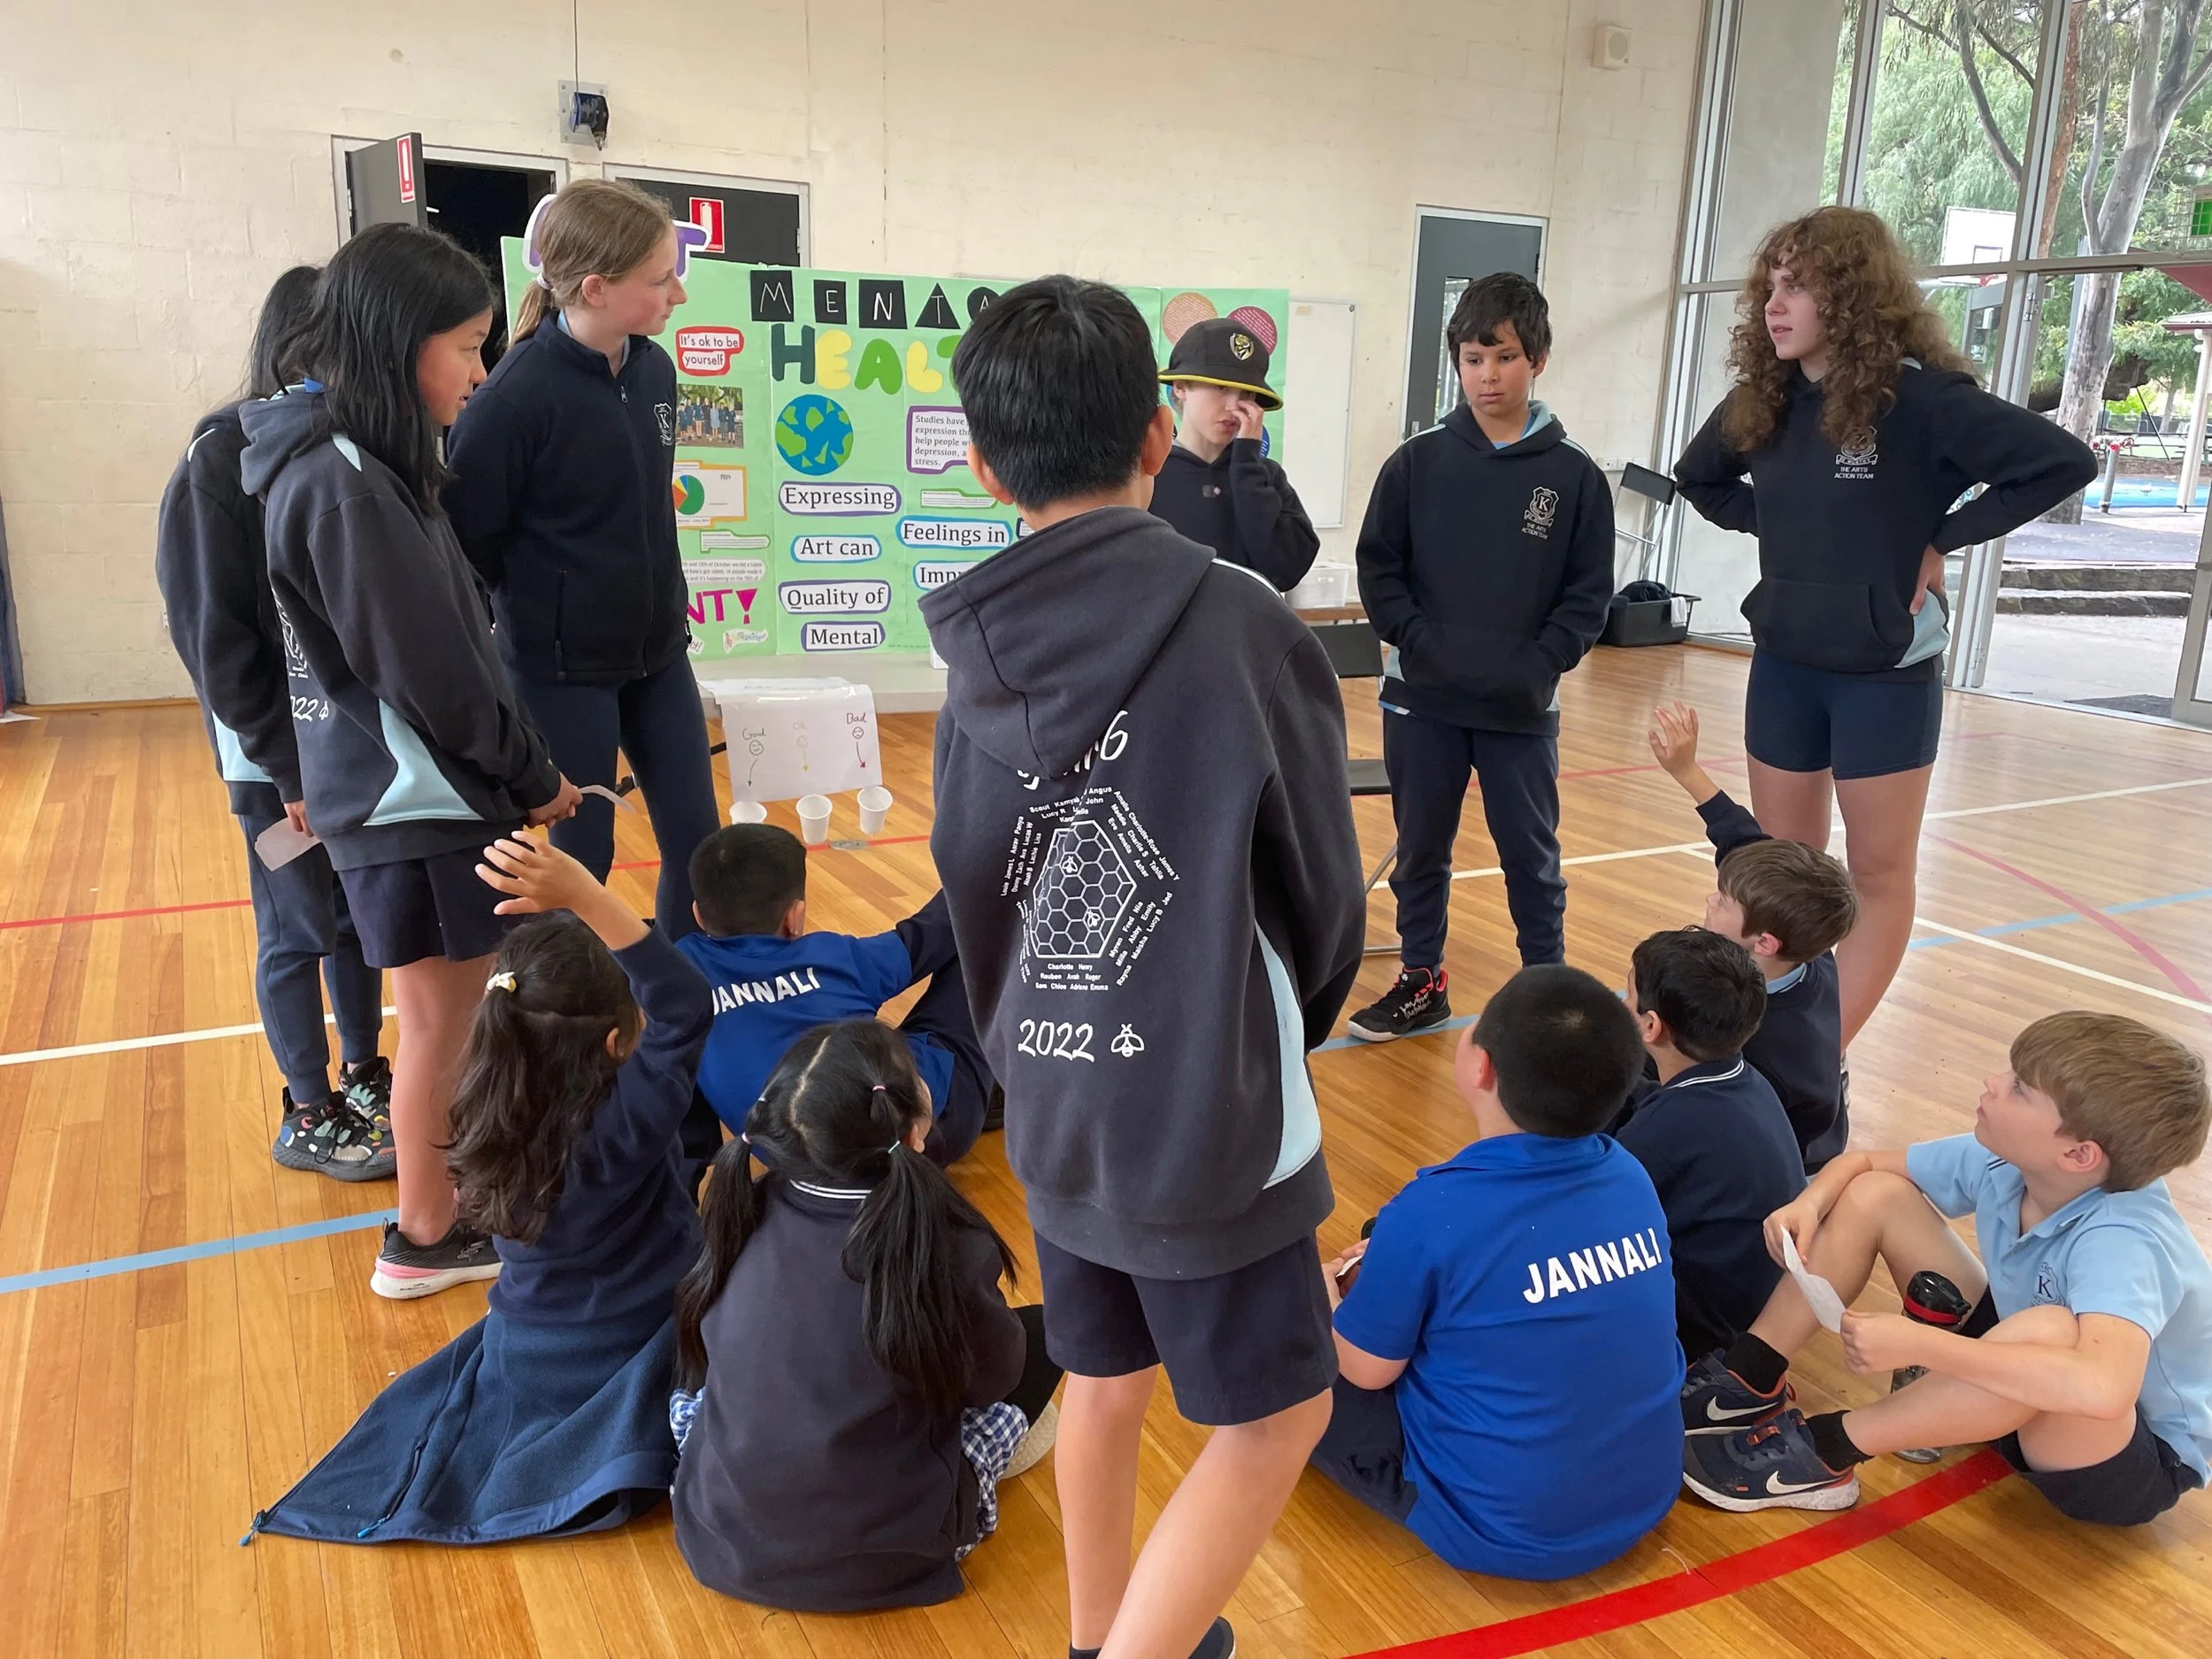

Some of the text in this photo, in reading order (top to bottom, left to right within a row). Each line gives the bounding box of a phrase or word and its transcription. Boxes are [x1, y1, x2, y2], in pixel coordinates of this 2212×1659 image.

[760, 281, 989, 325] MENTA
[680, 334, 738, 347] It's ok to be
[685, 354, 724, 366] yourself
[771, 323, 959, 395] HEAL
[915, 415, 944, 424] Studies
[915, 436, 932, 446] help
[933, 438, 959, 447] people
[915, 447, 960, 457] depression,
[784, 487, 895, 509] Expressing
[1538, 495, 1551, 512] K
[902, 523, 981, 545] Feelings
[987, 526, 1006, 543] in
[800, 538, 873, 556] Art can
[787, 588, 885, 610] Quality of
[810, 628, 879, 645] Mental
[847, 712, 867, 725] Bad
[741, 727, 767, 741] Good
[1100, 710, 1129, 761] 6
[1029, 804, 1050, 813] Scout
[1041, 810, 1059, 819] Lucy
[1022, 829, 1032, 846] Lucas
[1110, 803, 1127, 826] Maddie
[1127, 829, 1144, 852] Charlie
[1148, 859, 1164, 880] Tahlia
[1128, 811, 1161, 856] Charlotte-Rose
[1158, 856, 1175, 876] James
[1108, 817, 1149, 878] Eve Amelia Azhar
[1004, 863, 1014, 879] James
[1023, 872, 1032, 886] Noah
[1122, 916, 1135, 933] Fred
[1133, 901, 1144, 913] Nia
[1128, 926, 1142, 944] Abby
[1141, 901, 1156, 921] Emily
[1116, 964, 1133, 987] Rayna
[1146, 915, 1161, 933] Lucy
[1162, 891, 1173, 905] Jed
[1078, 963, 1094, 972] Henry
[1085, 972, 1102, 981] Roger
[711, 966, 821, 1016] JANNALI
[1018, 1018, 1094, 1062] 2022
[1523, 1227, 1663, 1304] JANNALI
[2038, 1274, 2054, 1300] K
